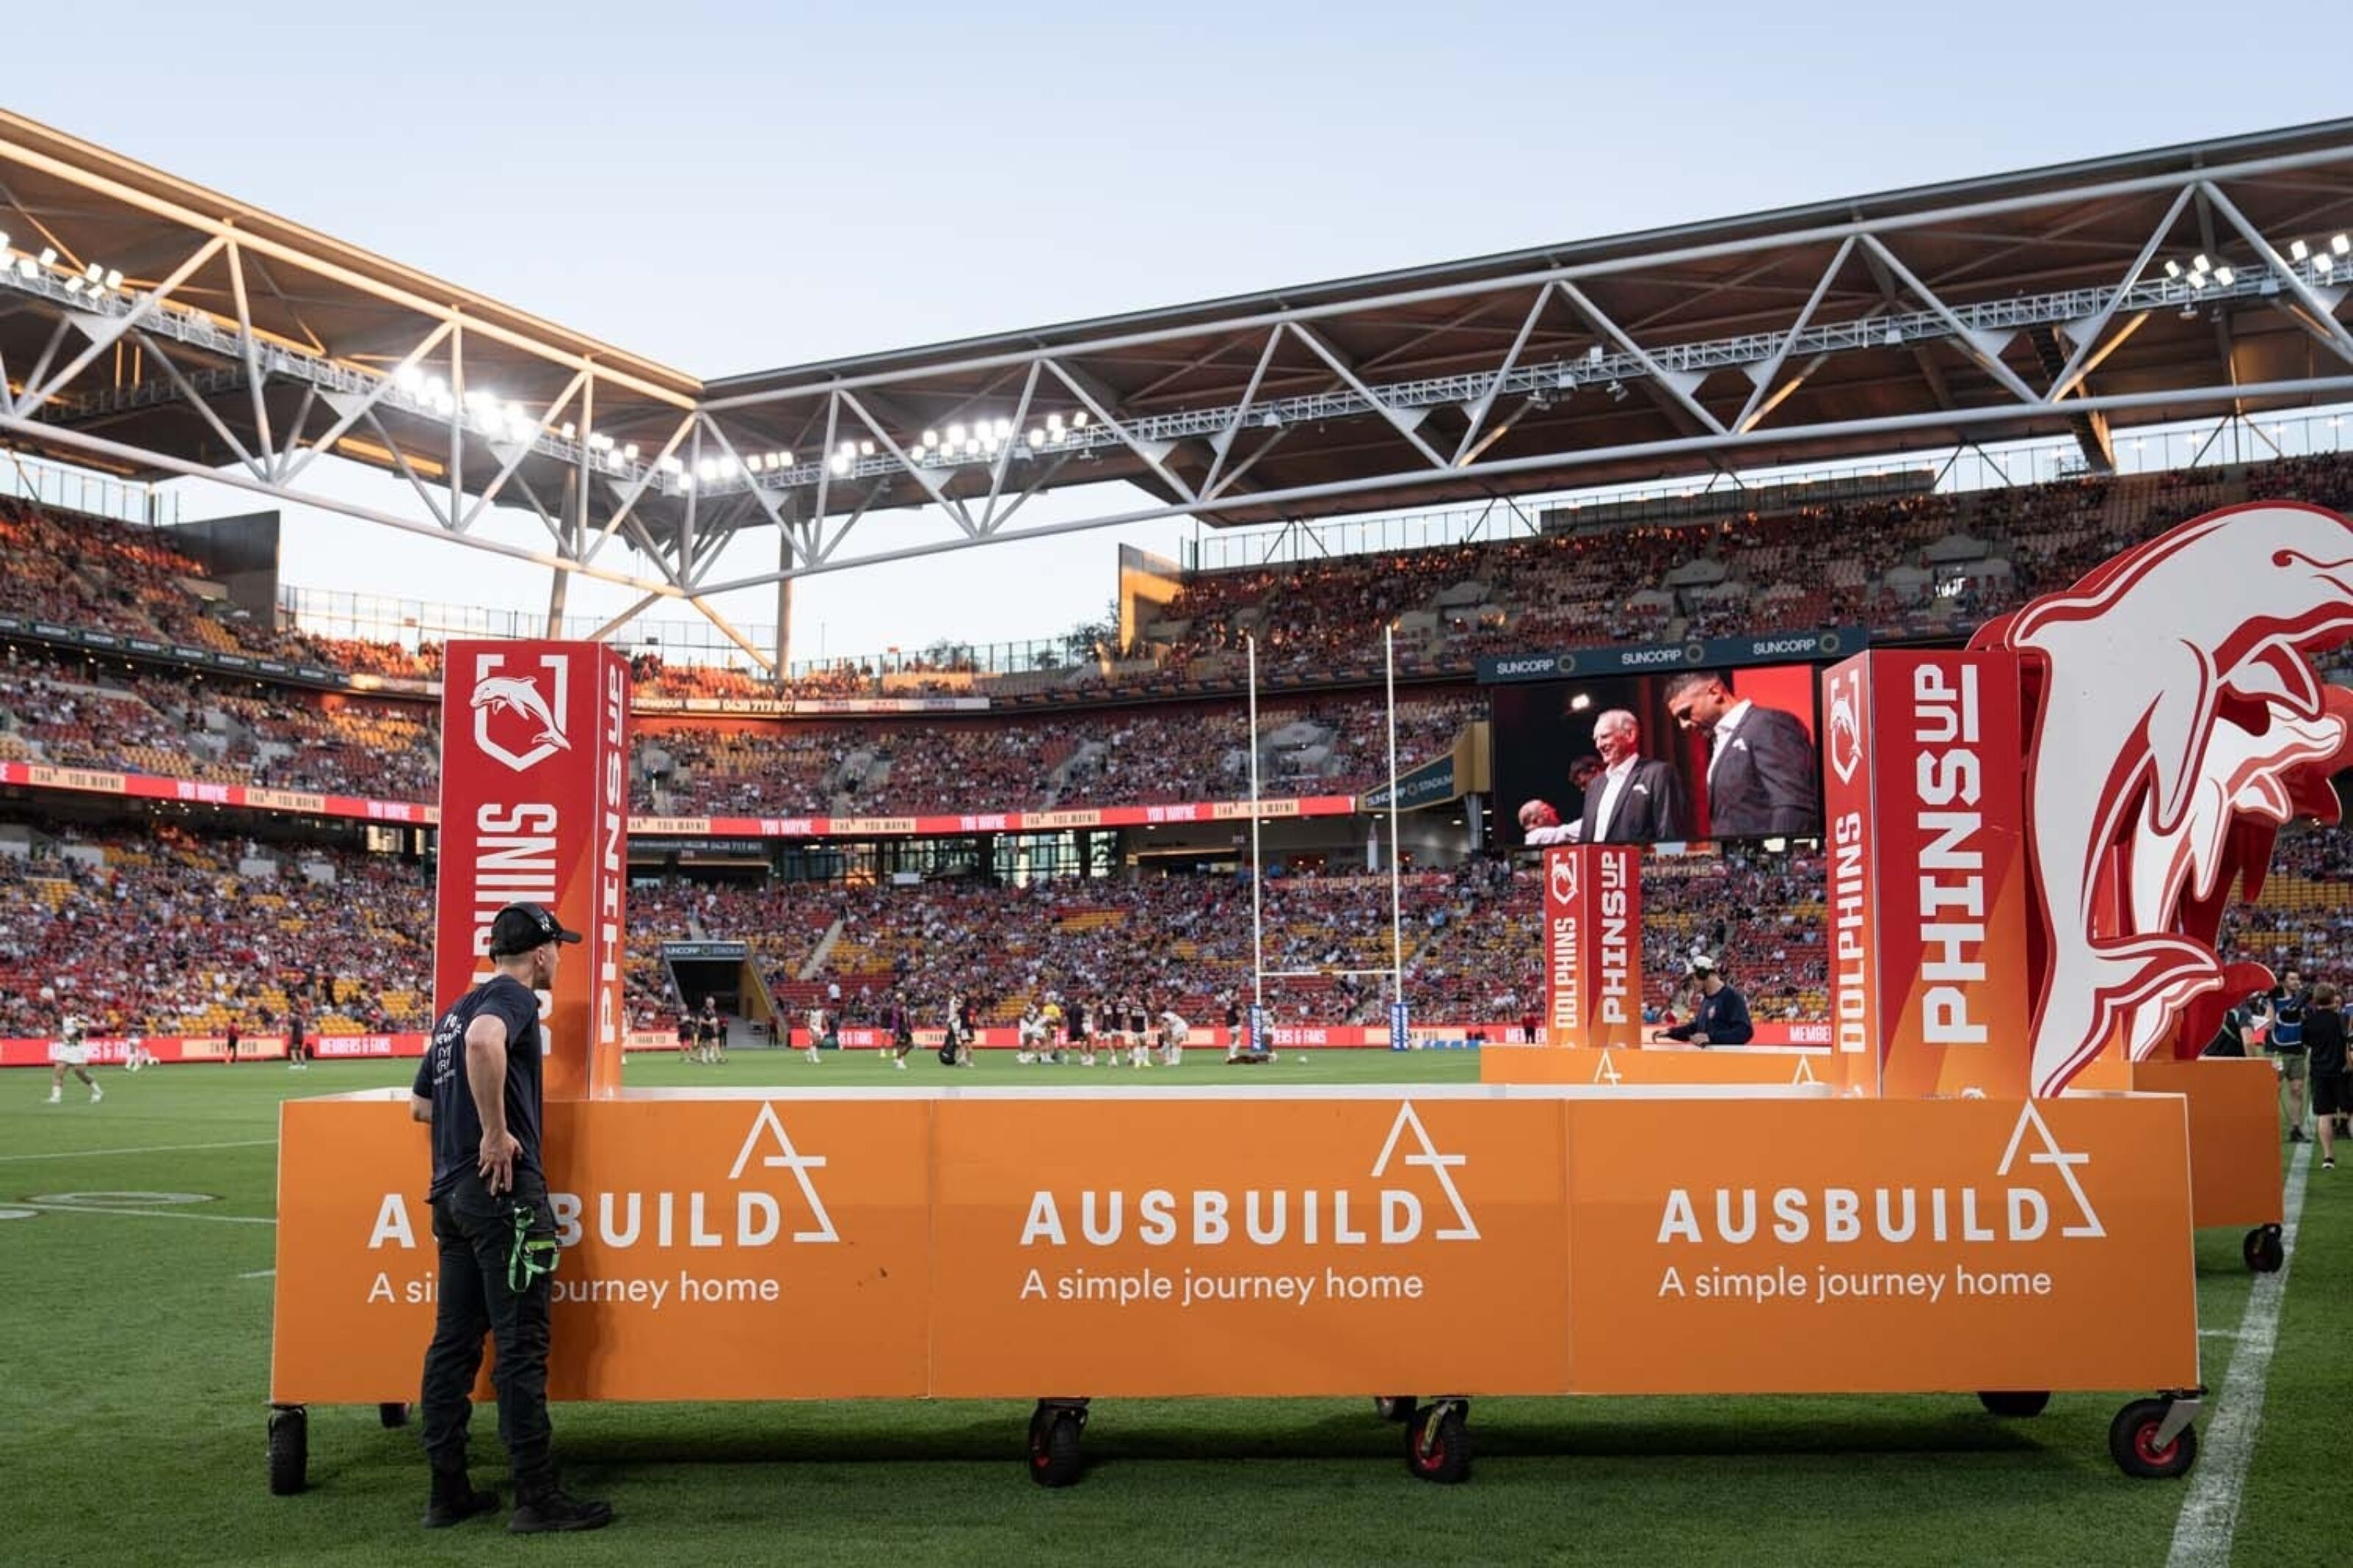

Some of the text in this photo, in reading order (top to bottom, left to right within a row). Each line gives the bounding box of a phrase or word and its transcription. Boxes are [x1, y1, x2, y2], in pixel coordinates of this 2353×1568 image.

[1621, 648, 1681, 665] SUNCORP
[1753, 638, 1815, 655] SUNCORP
[1496, 658, 1554, 676] SUNCORP
[1836, 812, 1866, 1053] DOLPHINS
[1554, 917, 1578, 1028] DOLPHINS
[1789, 1026, 1832, 1042] MEMBE
[368, 1192, 780, 1248] ABUILD
[1021, 1189, 1423, 1245] AUSBUILD
[1657, 1188, 2049, 1244] AUSBUILD
[368, 1273, 395, 1303] A
[549, 1270, 779, 1309] ourney home
[1021, 1267, 1423, 1306] A simple journey home
[1659, 1264, 2051, 1303] A simple journey home
